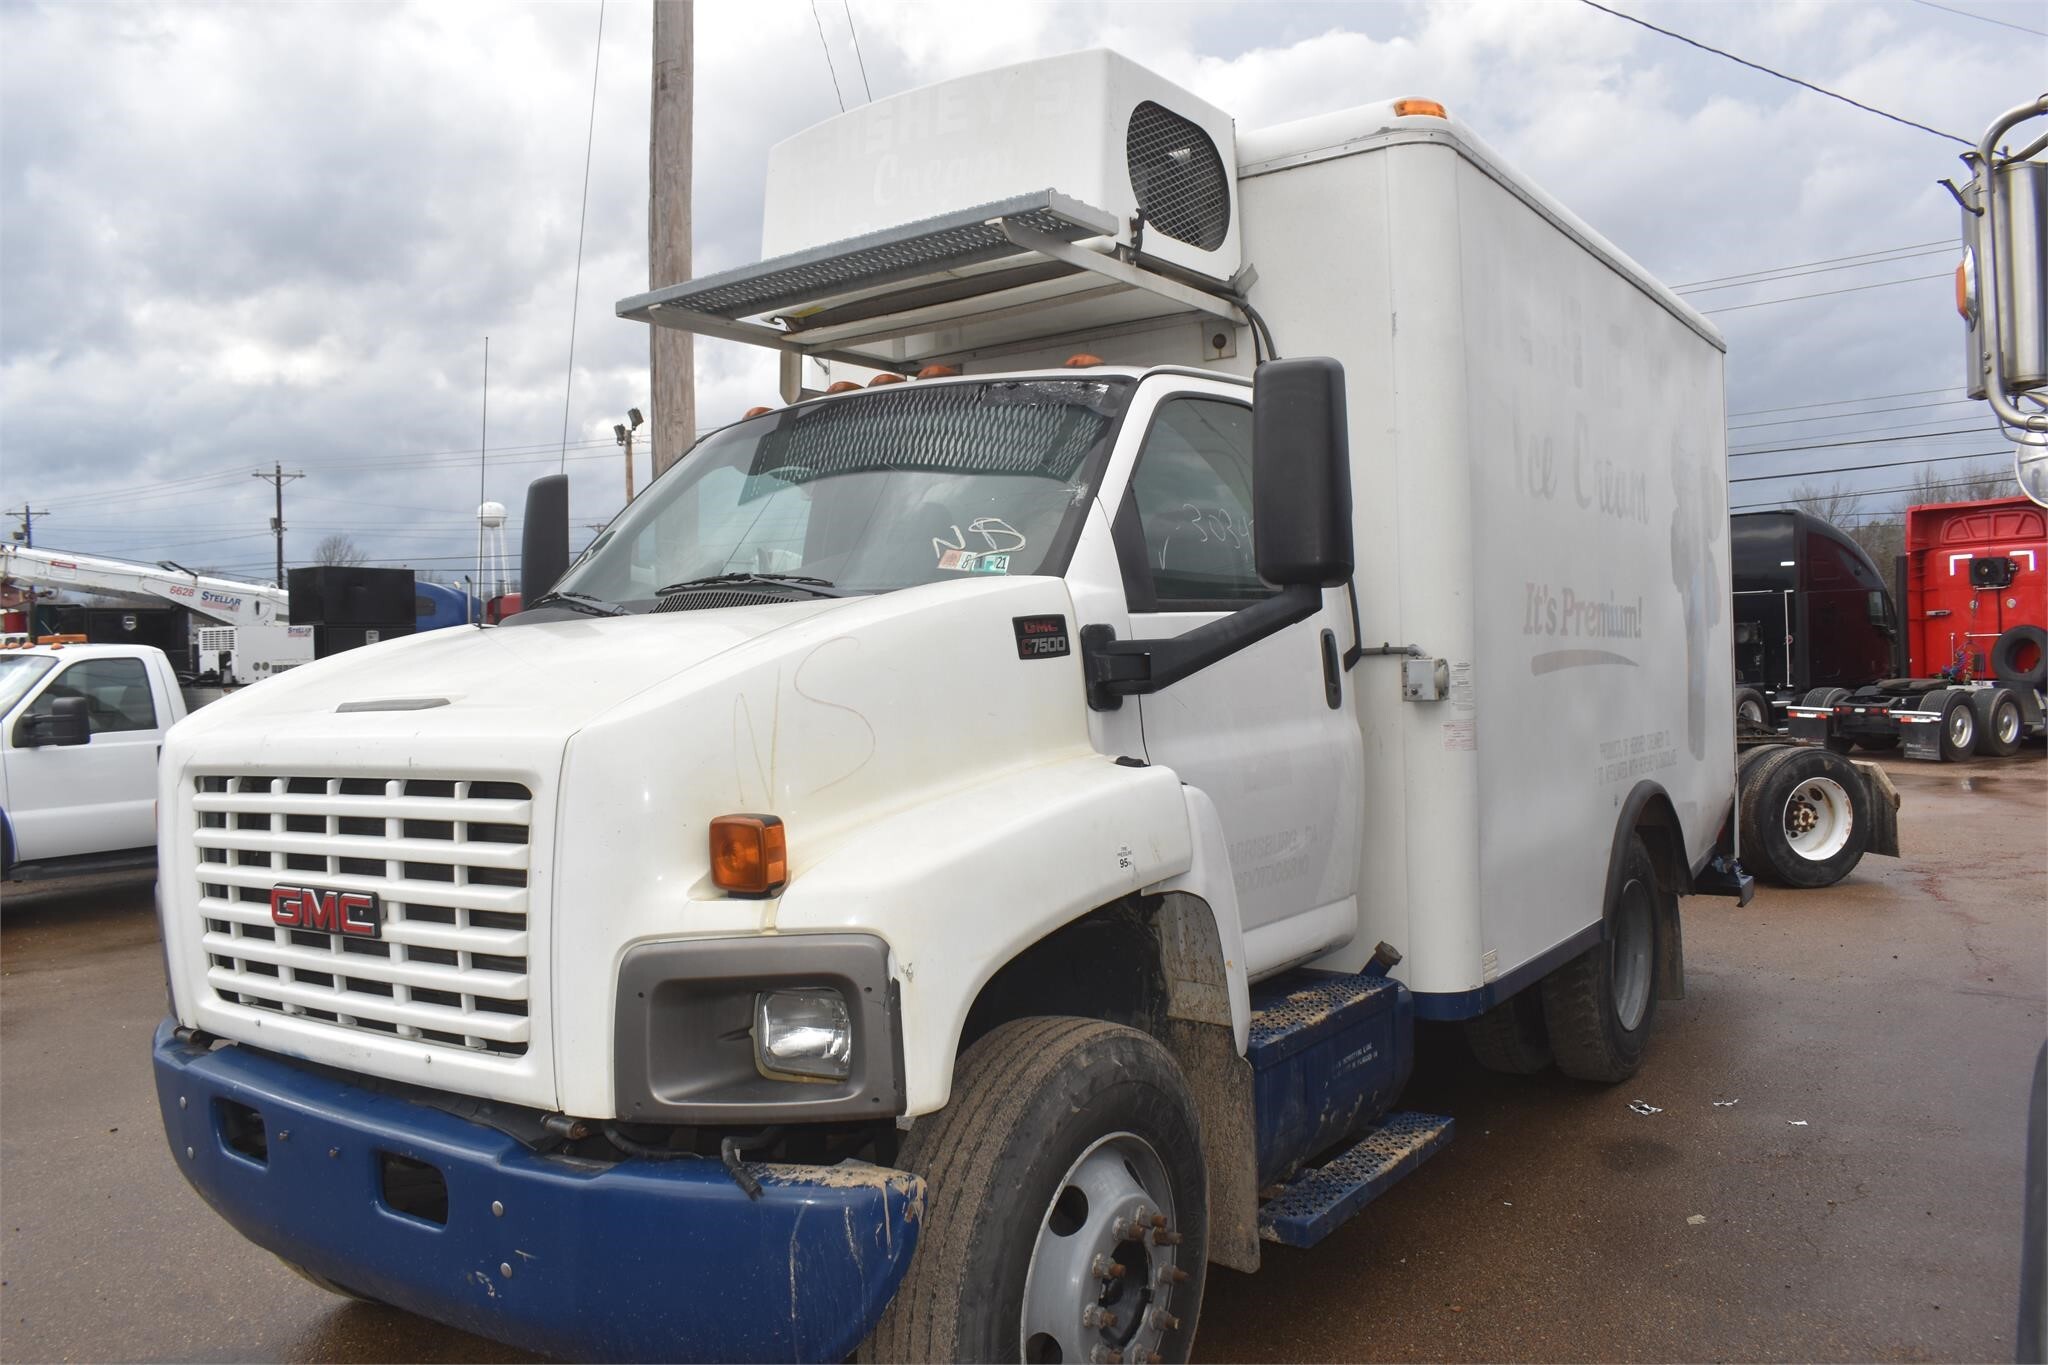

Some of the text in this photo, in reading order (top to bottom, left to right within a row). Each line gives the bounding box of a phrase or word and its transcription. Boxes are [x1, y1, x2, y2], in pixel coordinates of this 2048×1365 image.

[169, 585, 242, 606] 6628 STELLAR
[1021, 636, 1066, 655] C7500
[1119, 857, 1129, 869] 95
[270, 884, 376, 937] GMC
